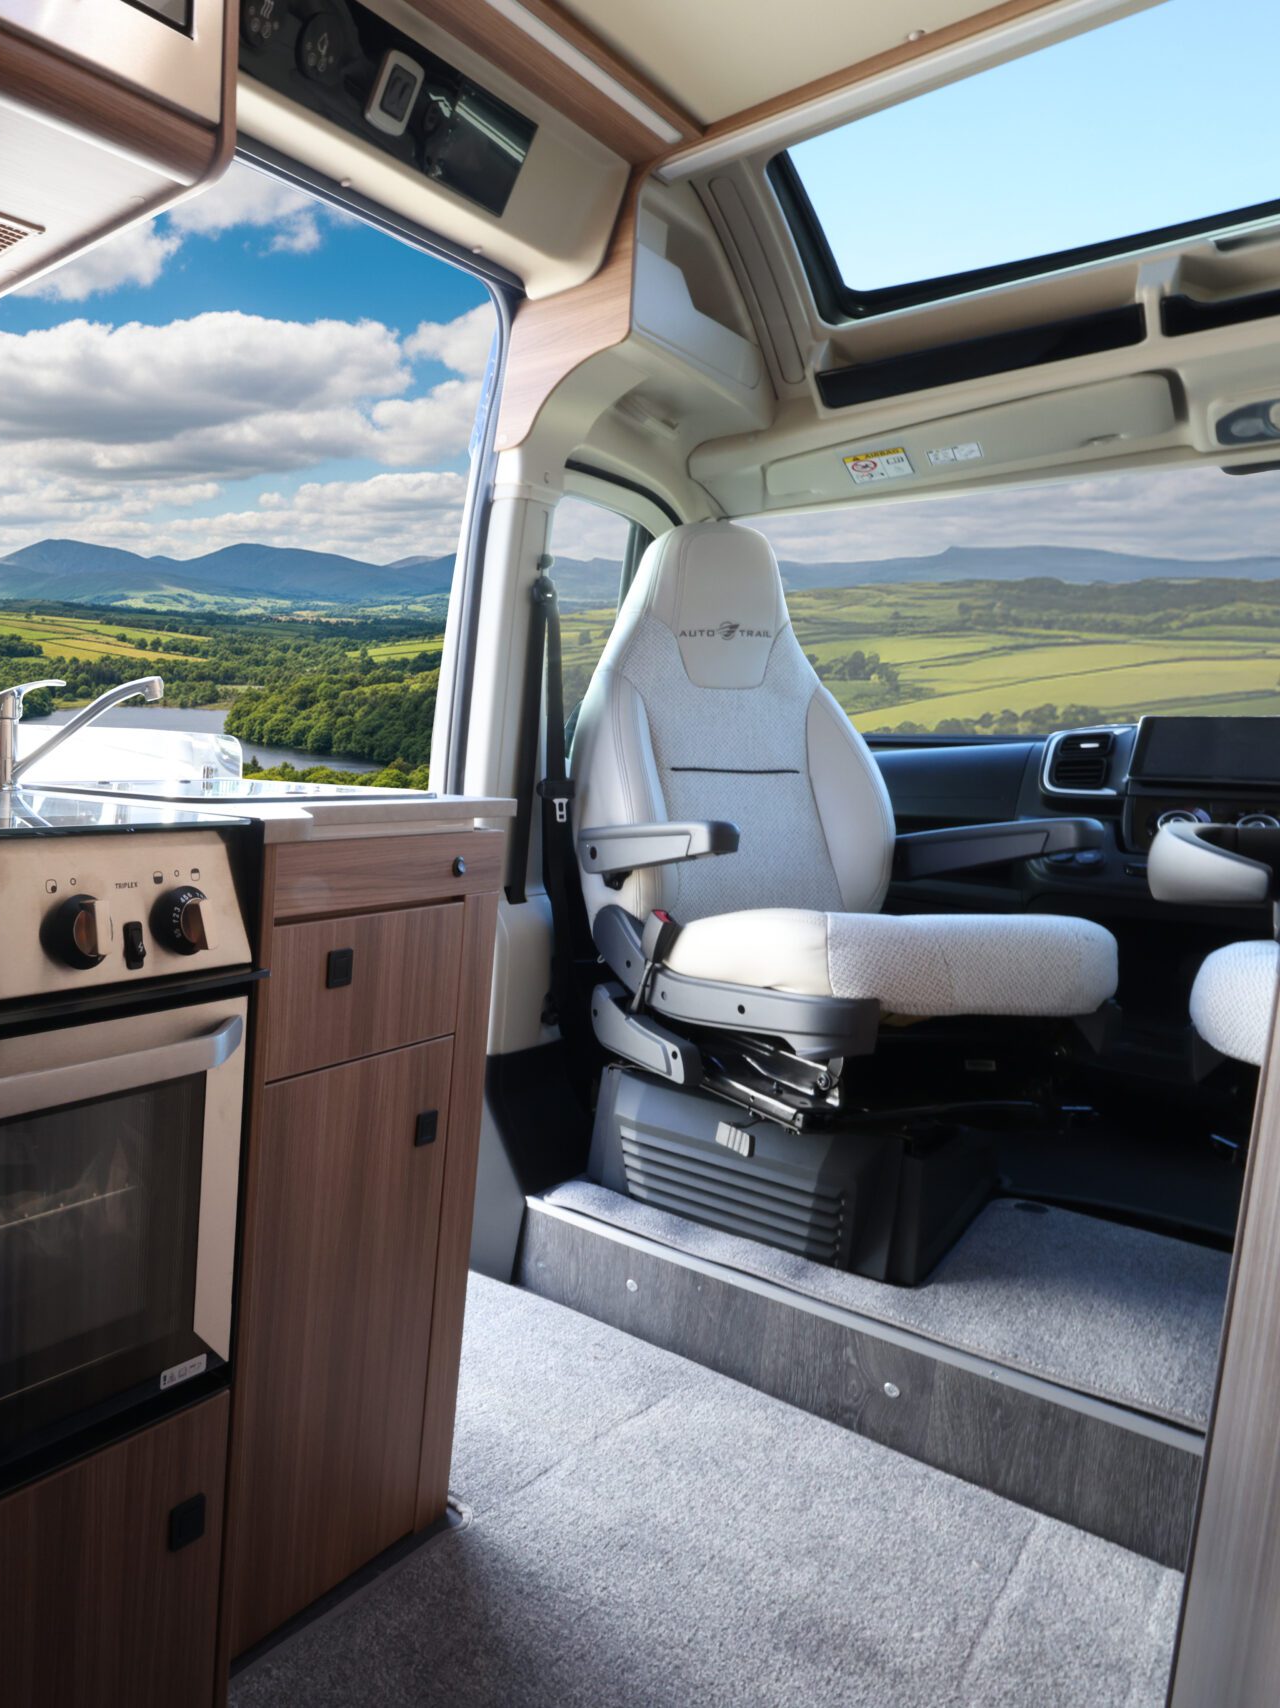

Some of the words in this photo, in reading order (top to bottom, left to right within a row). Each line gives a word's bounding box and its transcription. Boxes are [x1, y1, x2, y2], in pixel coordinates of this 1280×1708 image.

[679, 629, 715, 637] AUTO
[739, 629, 772, 638] TRAIL
[115, 881, 138, 889] TRIPLEX
